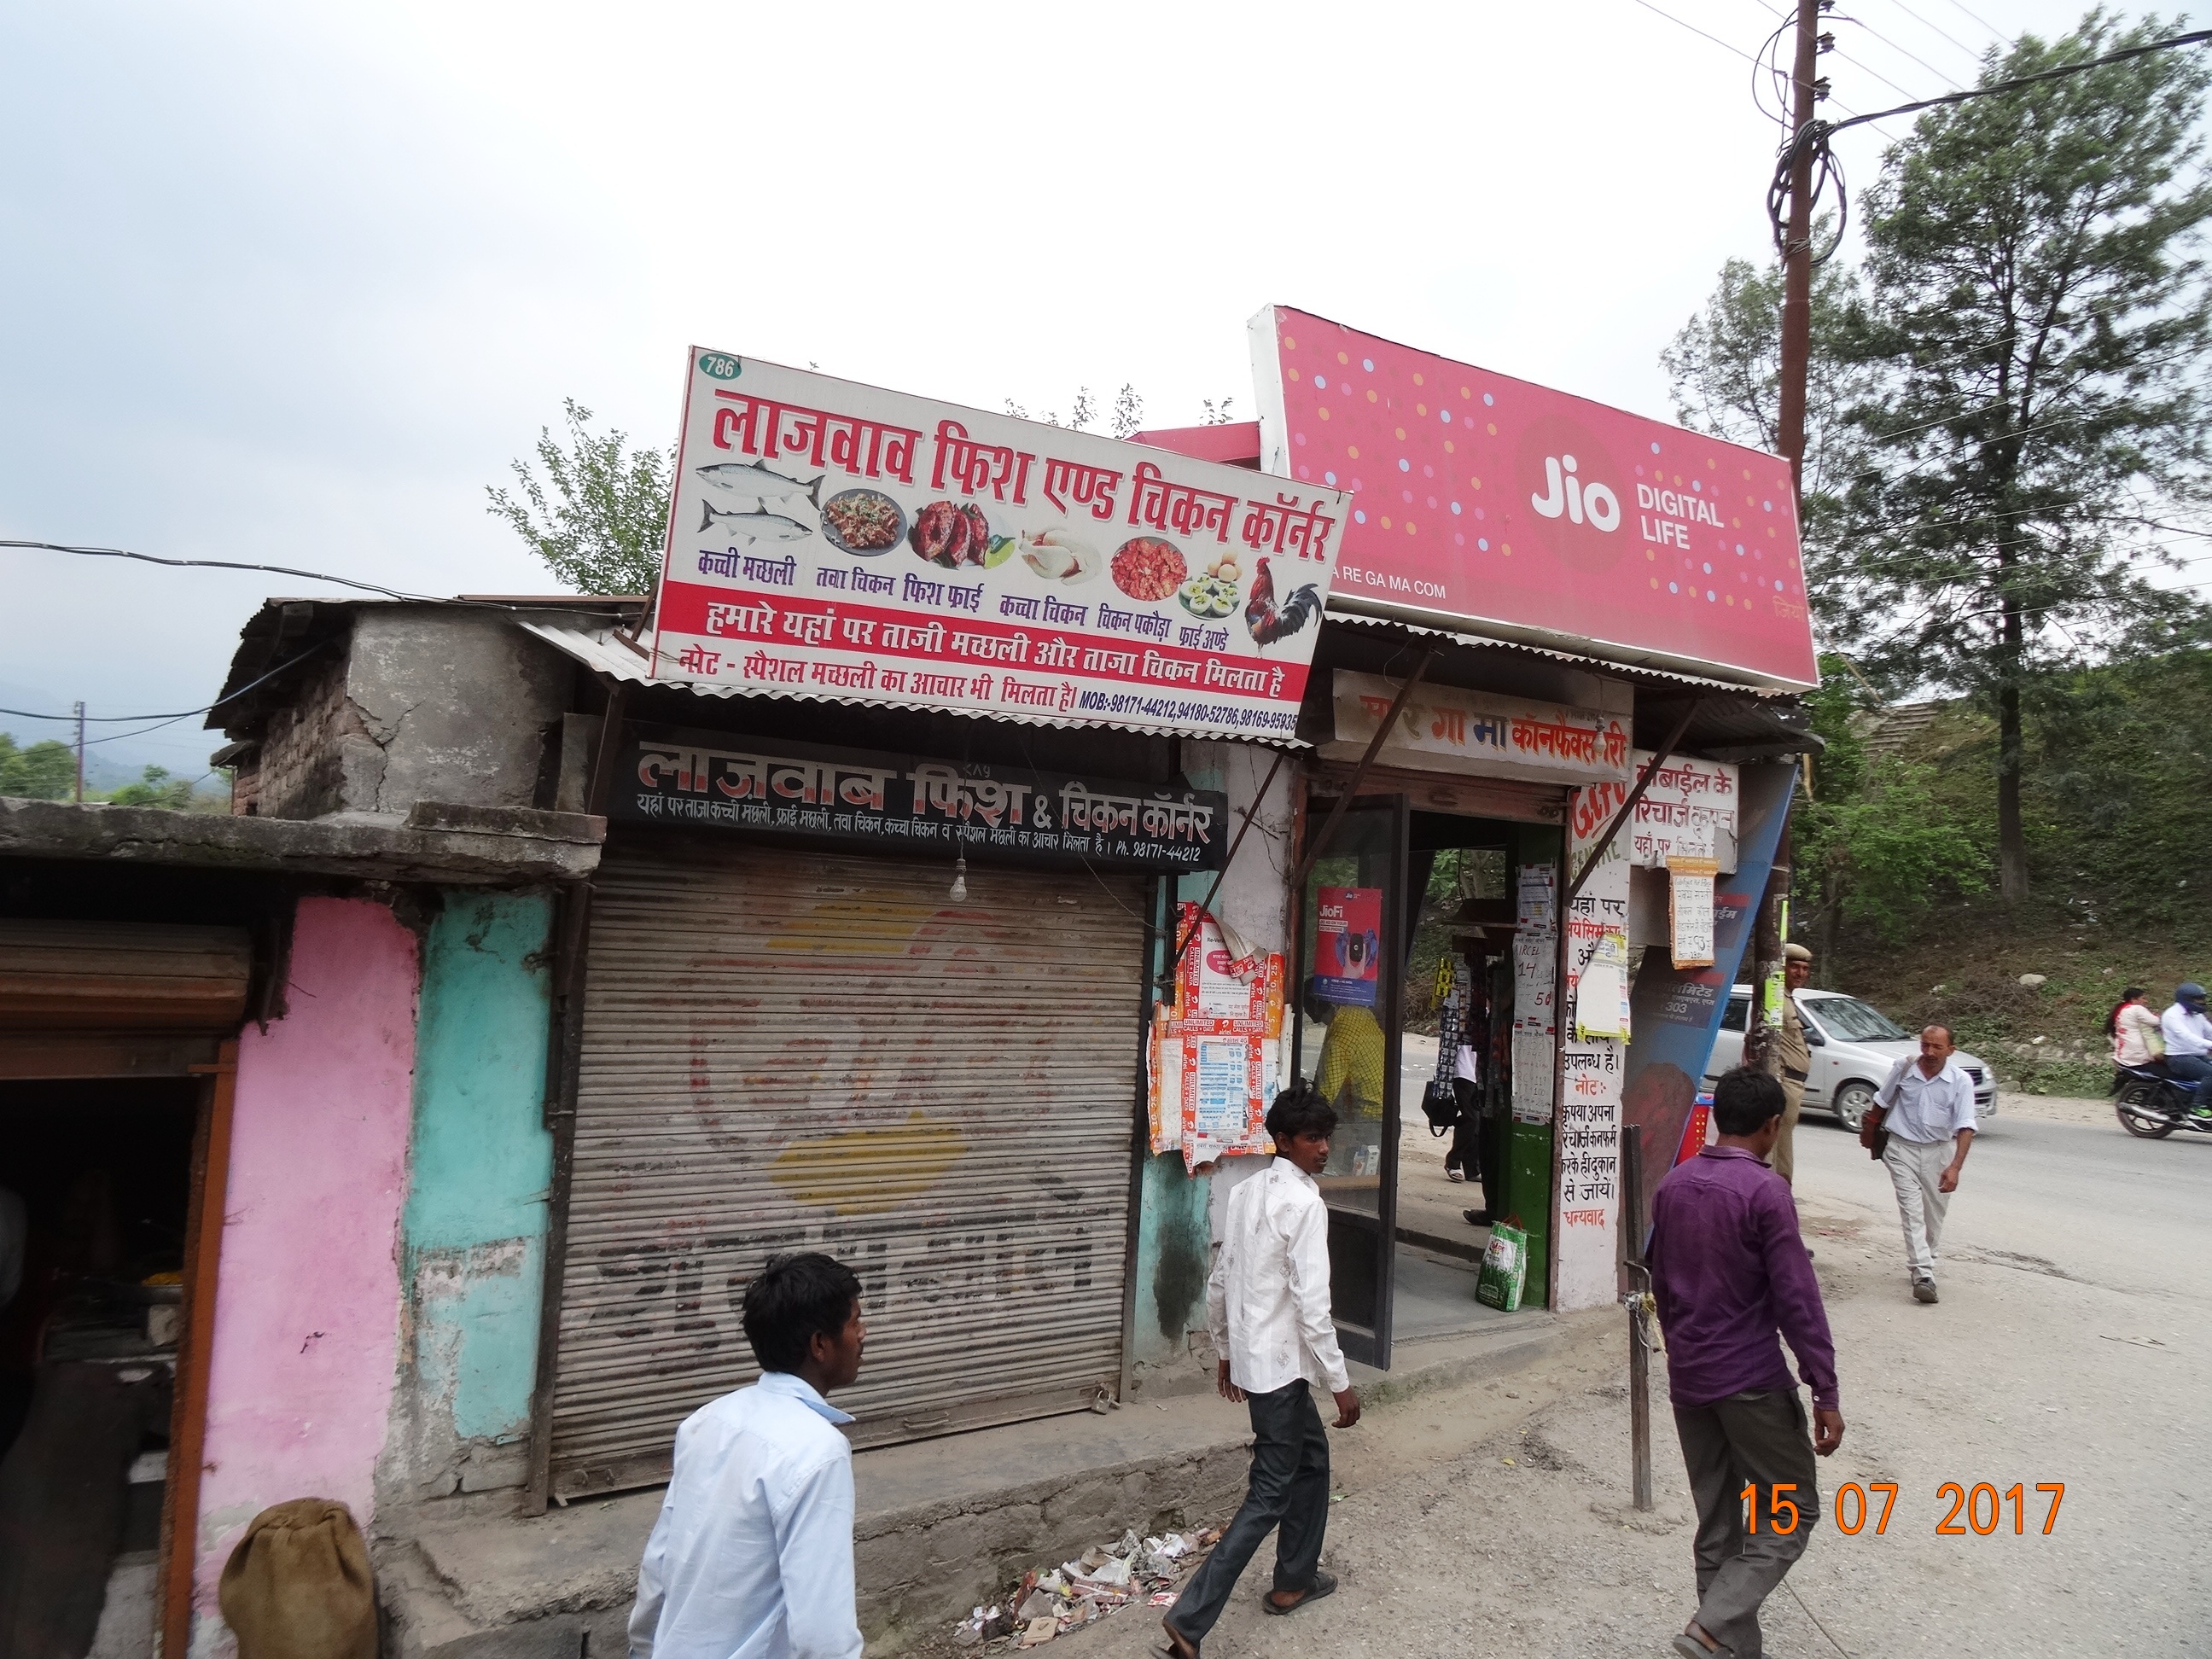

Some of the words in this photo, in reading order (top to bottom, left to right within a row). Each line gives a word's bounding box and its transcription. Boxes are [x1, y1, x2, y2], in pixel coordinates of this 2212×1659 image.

[706, 356, 734, 378] 786
[930, 419, 1036, 505] फिश
[1044, 458, 1123, 521] एण्ड
[1127, 462, 1240, 543] चिकन
[1243, 492, 1335, 562] कॉर्नर
[1531, 454, 1621, 533] Jio
[1636, 483, 1726, 529] DIGITAL
[1640, 515, 1691, 550] LIFE
[816, 567, 849, 590] तवा
[851, 565, 896, 596] चिकन
[902, 573, 945, 606] फिश
[947, 582, 984, 613] फ्राई
[999, 594, 1040, 620] कच्चा
[1041, 595, 1088, 626] चिकन
[1097, 602, 1133, 632] चिकन
[1342, 566, 1362, 583] RE
[1365, 570, 1386, 588] GA
[1388, 575, 1412, 592] MA
[1413, 580, 1447, 599] COM
[706, 600, 777, 636] हमारे
[782, 608, 837, 647] यहां
[841, 616, 878, 645] पर
[881, 620, 947, 653] ताजी
[950, 631, 1031, 663] मच्छली
[1033, 636, 1080, 668] और
[1082, 646, 1138, 675] ताजा
[1141, 649, 1202, 683] चिकन
[1203, 657, 1268, 692] मिलता
[1269, 666, 1285, 698] है
[678, 643, 721, 675] नोट
[811, 661, 878, 690] मच्छली
[880, 669, 908, 693] का
[910, 672, 968, 698] आचार
[970, 672, 993, 701] भी
[1000, 676, 1057, 707] मिलता
[1472, 712, 1511, 751] मा
[1713, 767, 1732, 795] के
[906, 762, 1032, 828] फिश
[1033, 795, 1053, 829] &
[1058, 780, 1142, 836] चिकन
[1144, 791, 1214, 844] कॉर्नर
[637, 791, 665, 818] यहां
[667, 797, 684, 816] पर
[834, 812, 852, 832] तवा
[911, 816, 938, 841] चिकन
[942, 824, 953, 841] व
[1018, 830, 1031, 847] का
[1033, 831, 1058, 852] आचार
[1062, 831, 1091, 853] मिलता
[1116, 842, 1130, 856] Ph.
[1133, 843, 1202, 862] 98171-44212
[1319, 905, 1343, 918] JioFi
[1600, 899, 1626, 916] पर
[1588, 1104, 1615, 1122] अपना
[1580, 1151, 1592, 1179] ही
[1591, 1156, 1617, 1181] दुकान
[1563, 1179, 1575, 1202] से
[1563, 1208, 1605, 1229] धन्यवाद
